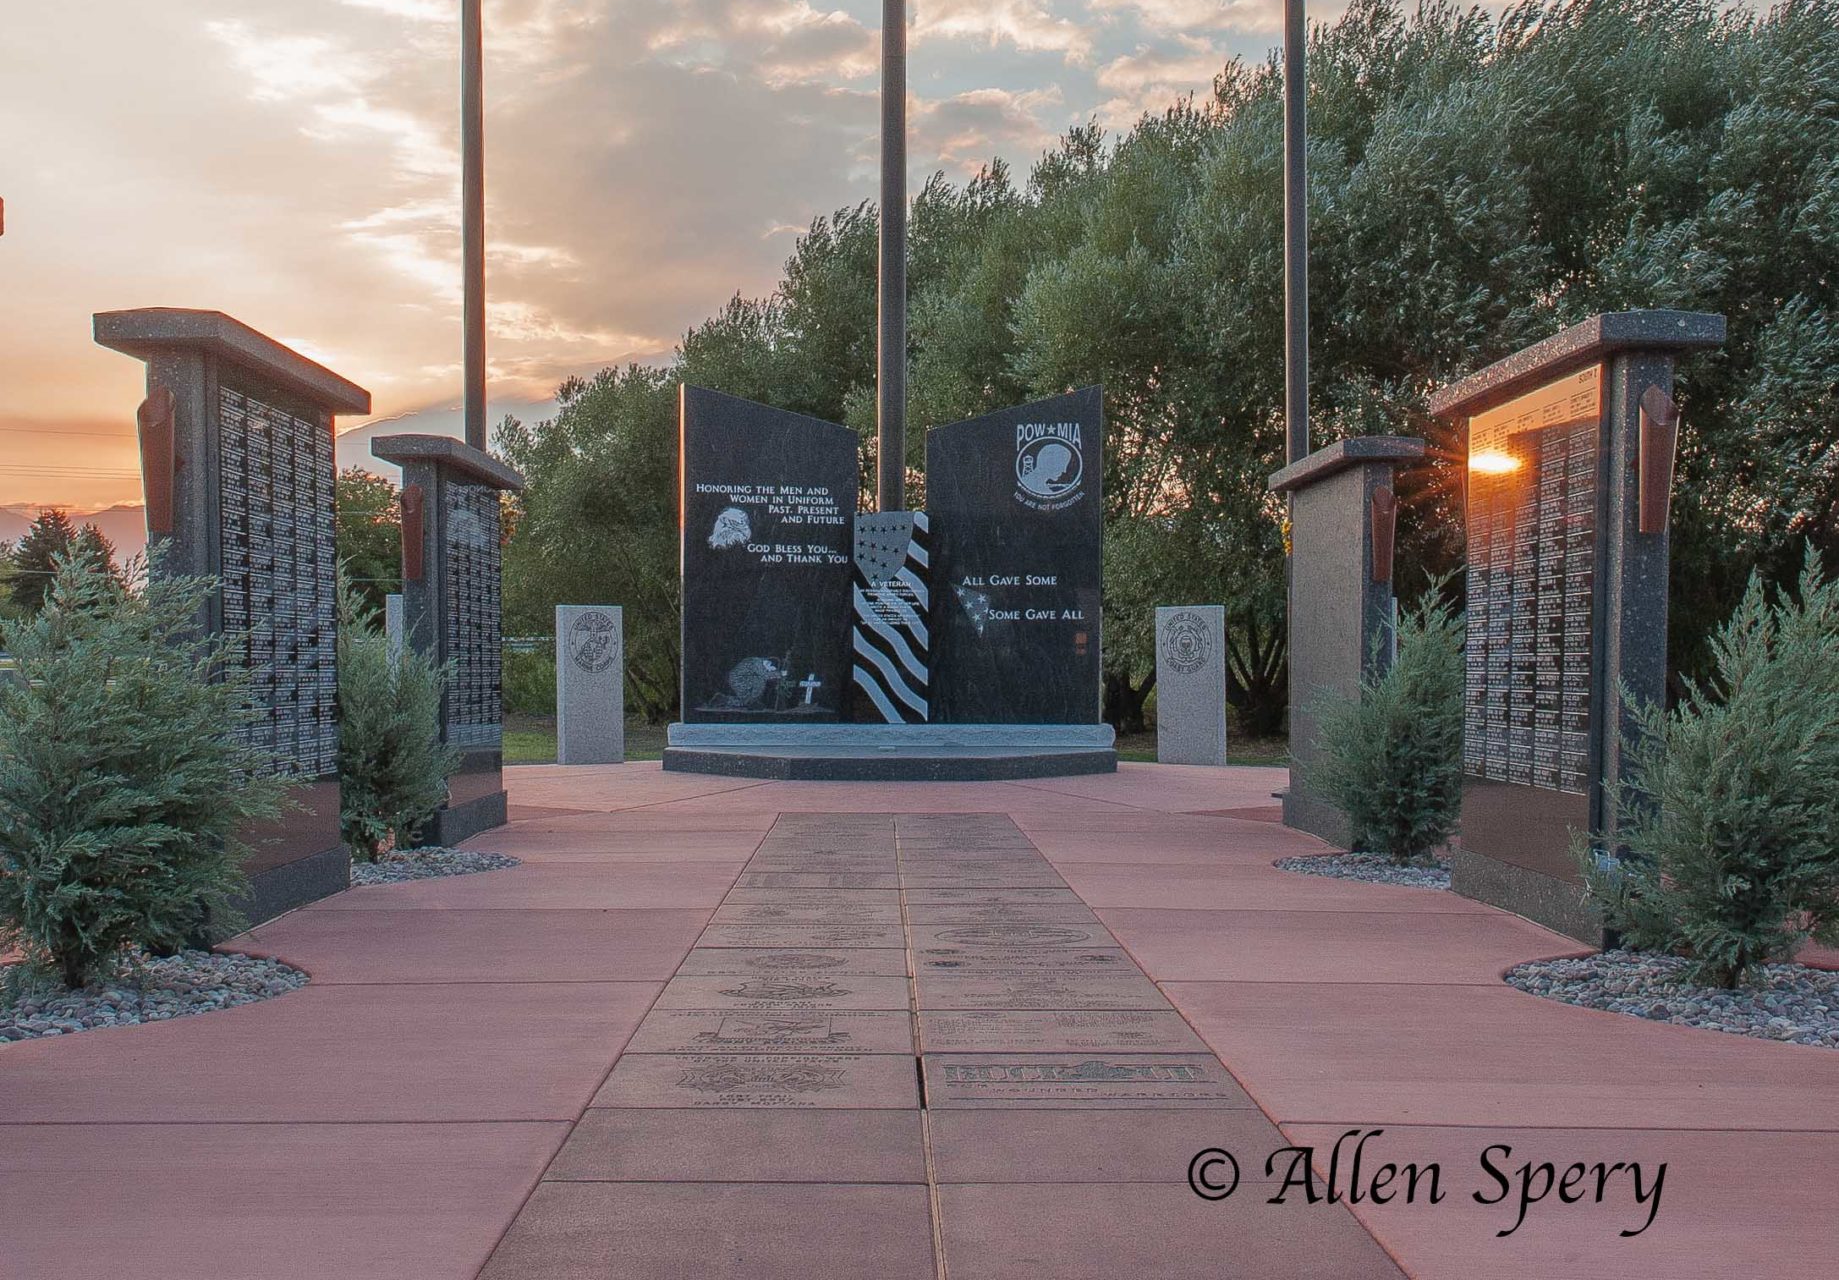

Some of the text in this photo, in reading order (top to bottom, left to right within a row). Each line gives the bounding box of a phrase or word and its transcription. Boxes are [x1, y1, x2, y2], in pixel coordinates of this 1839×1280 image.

[1016, 422, 1082, 452] POW MIA
[696, 483, 829, 496] HONORING THE MEN AND
[730, 494, 834, 505] WOMEN IN UNIFORM
[798, 505, 839, 515] PRESENT
[781, 515, 845, 525] AND FUTURE
[747, 543, 770, 553] GOD
[775, 544, 802, 554] BLESS
[760, 554, 848, 564] AND THANK YOU
[962, 574, 1057, 586] ALL GAVE SOME
[988, 608, 1085, 620] SOME GAVE ALL
